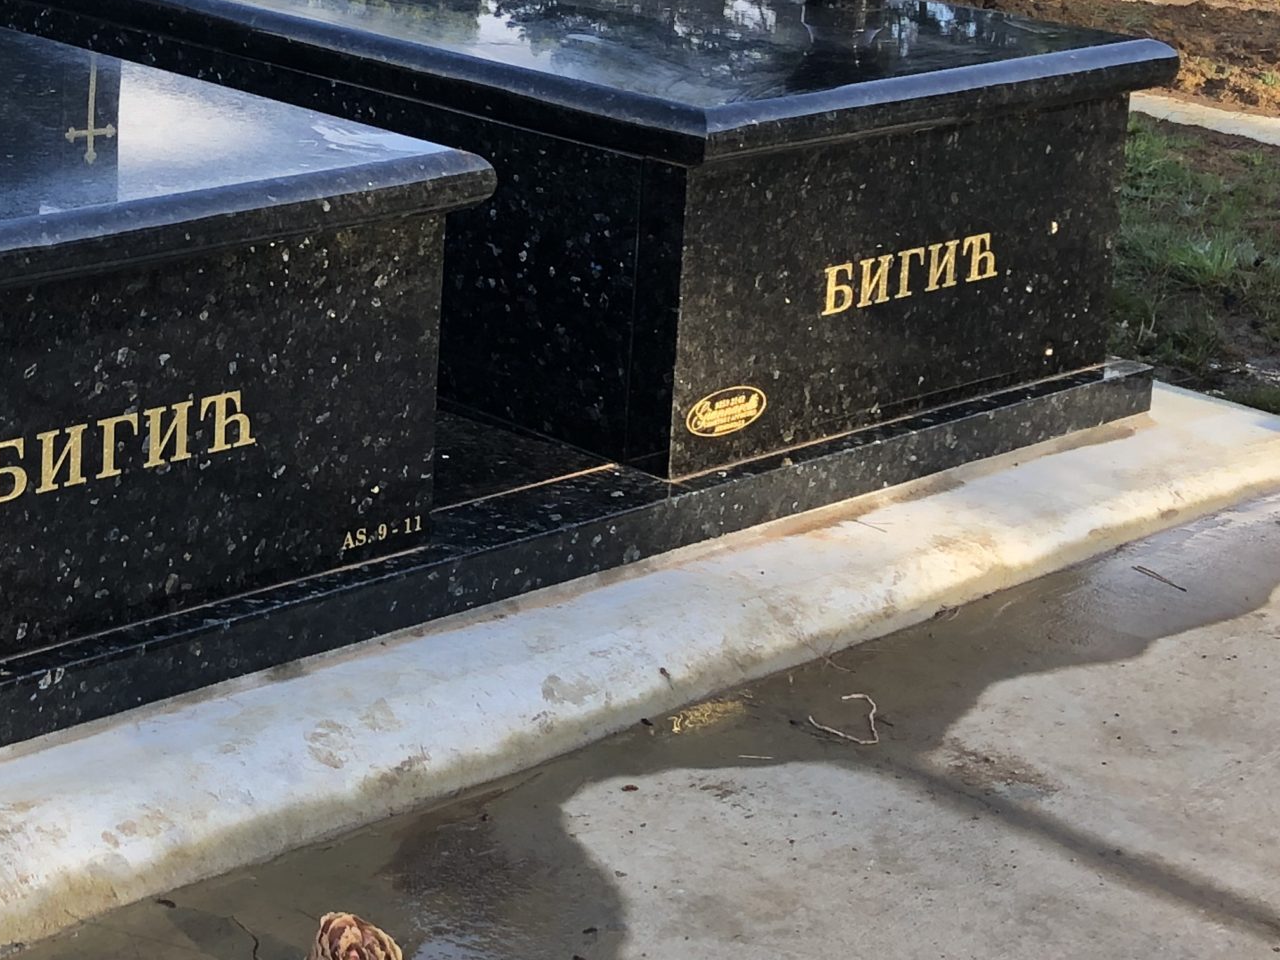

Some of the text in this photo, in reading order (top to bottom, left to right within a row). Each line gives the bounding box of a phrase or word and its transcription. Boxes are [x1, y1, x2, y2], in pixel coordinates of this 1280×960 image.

[821, 232, 998, 316] БИГИЋ
[378, 523, 388, 541] 9
[404, 515, 422, 534] 11
